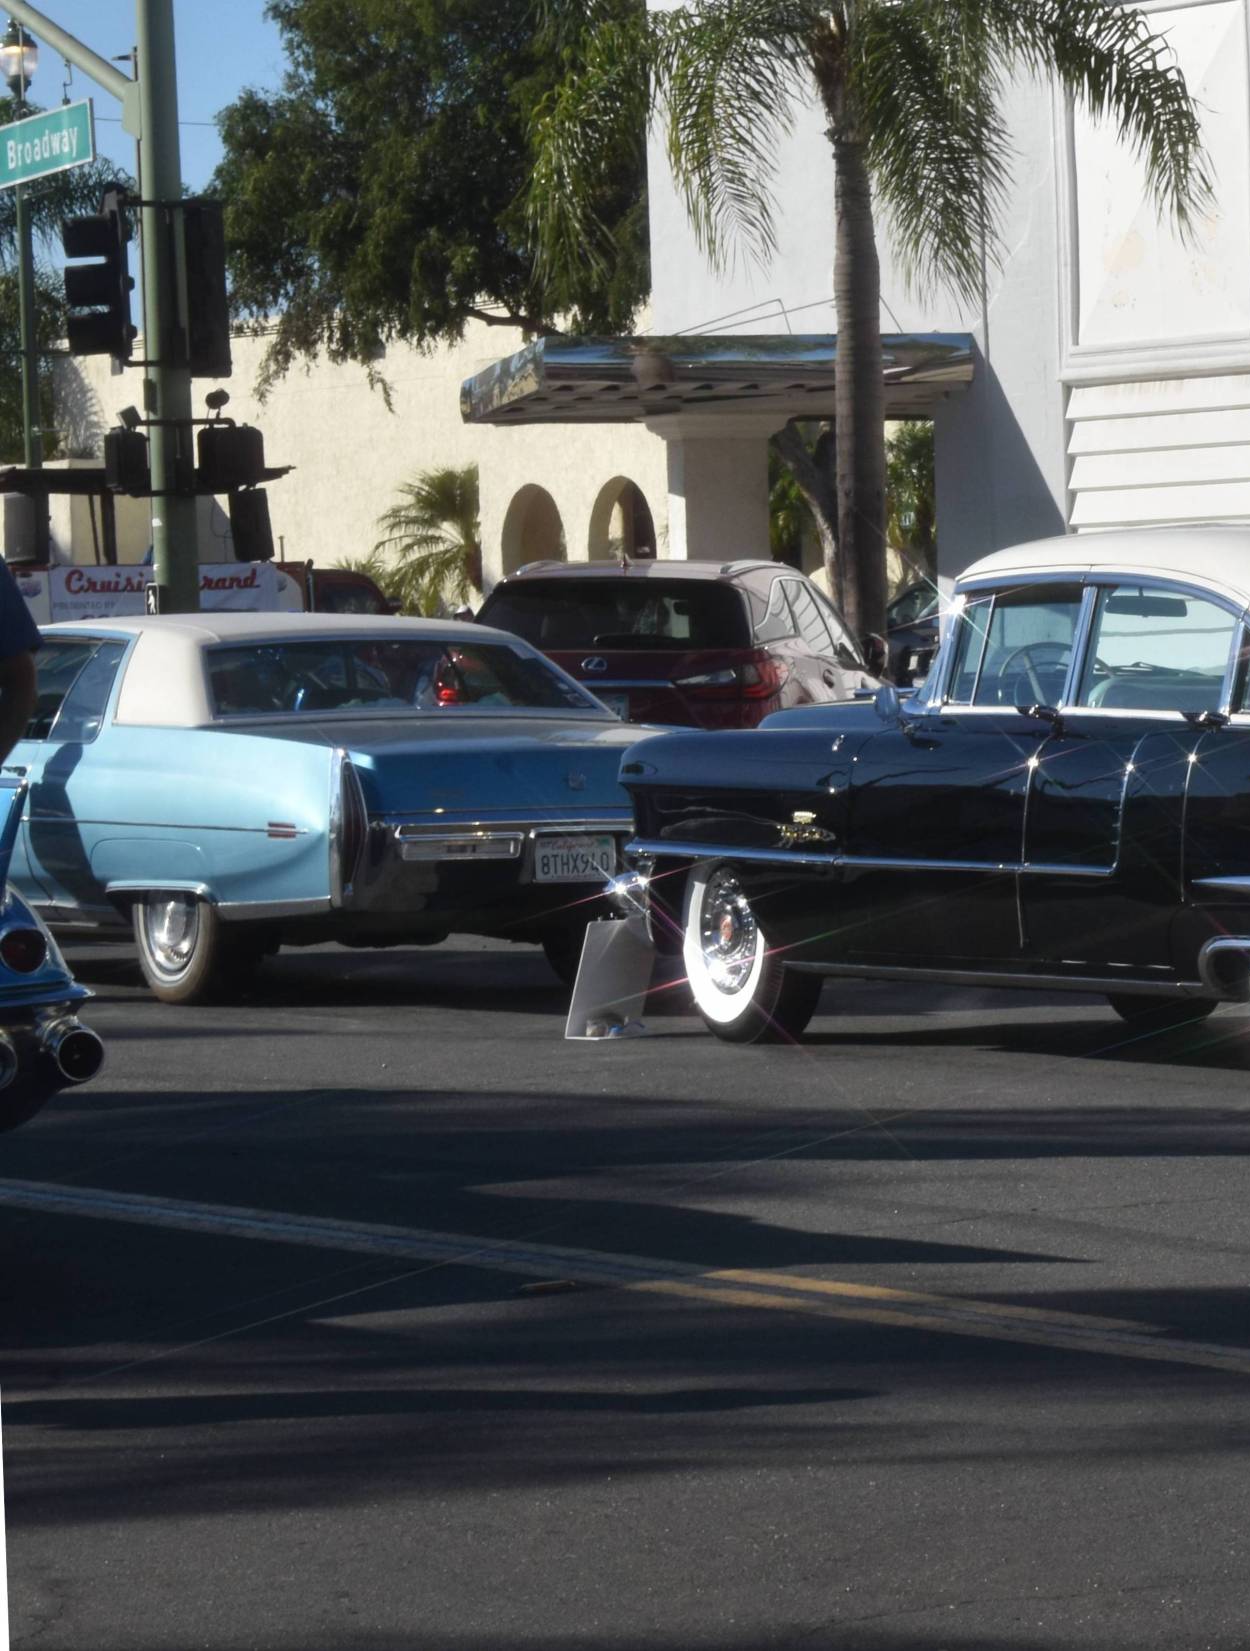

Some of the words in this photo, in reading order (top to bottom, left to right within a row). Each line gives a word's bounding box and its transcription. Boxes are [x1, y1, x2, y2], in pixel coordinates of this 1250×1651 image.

[7, 127, 78, 170] Broadway
[65, 568, 146, 595] Cruisi
[199, 567, 261, 591] rand
[541, 852, 610, 876] 8THX940
